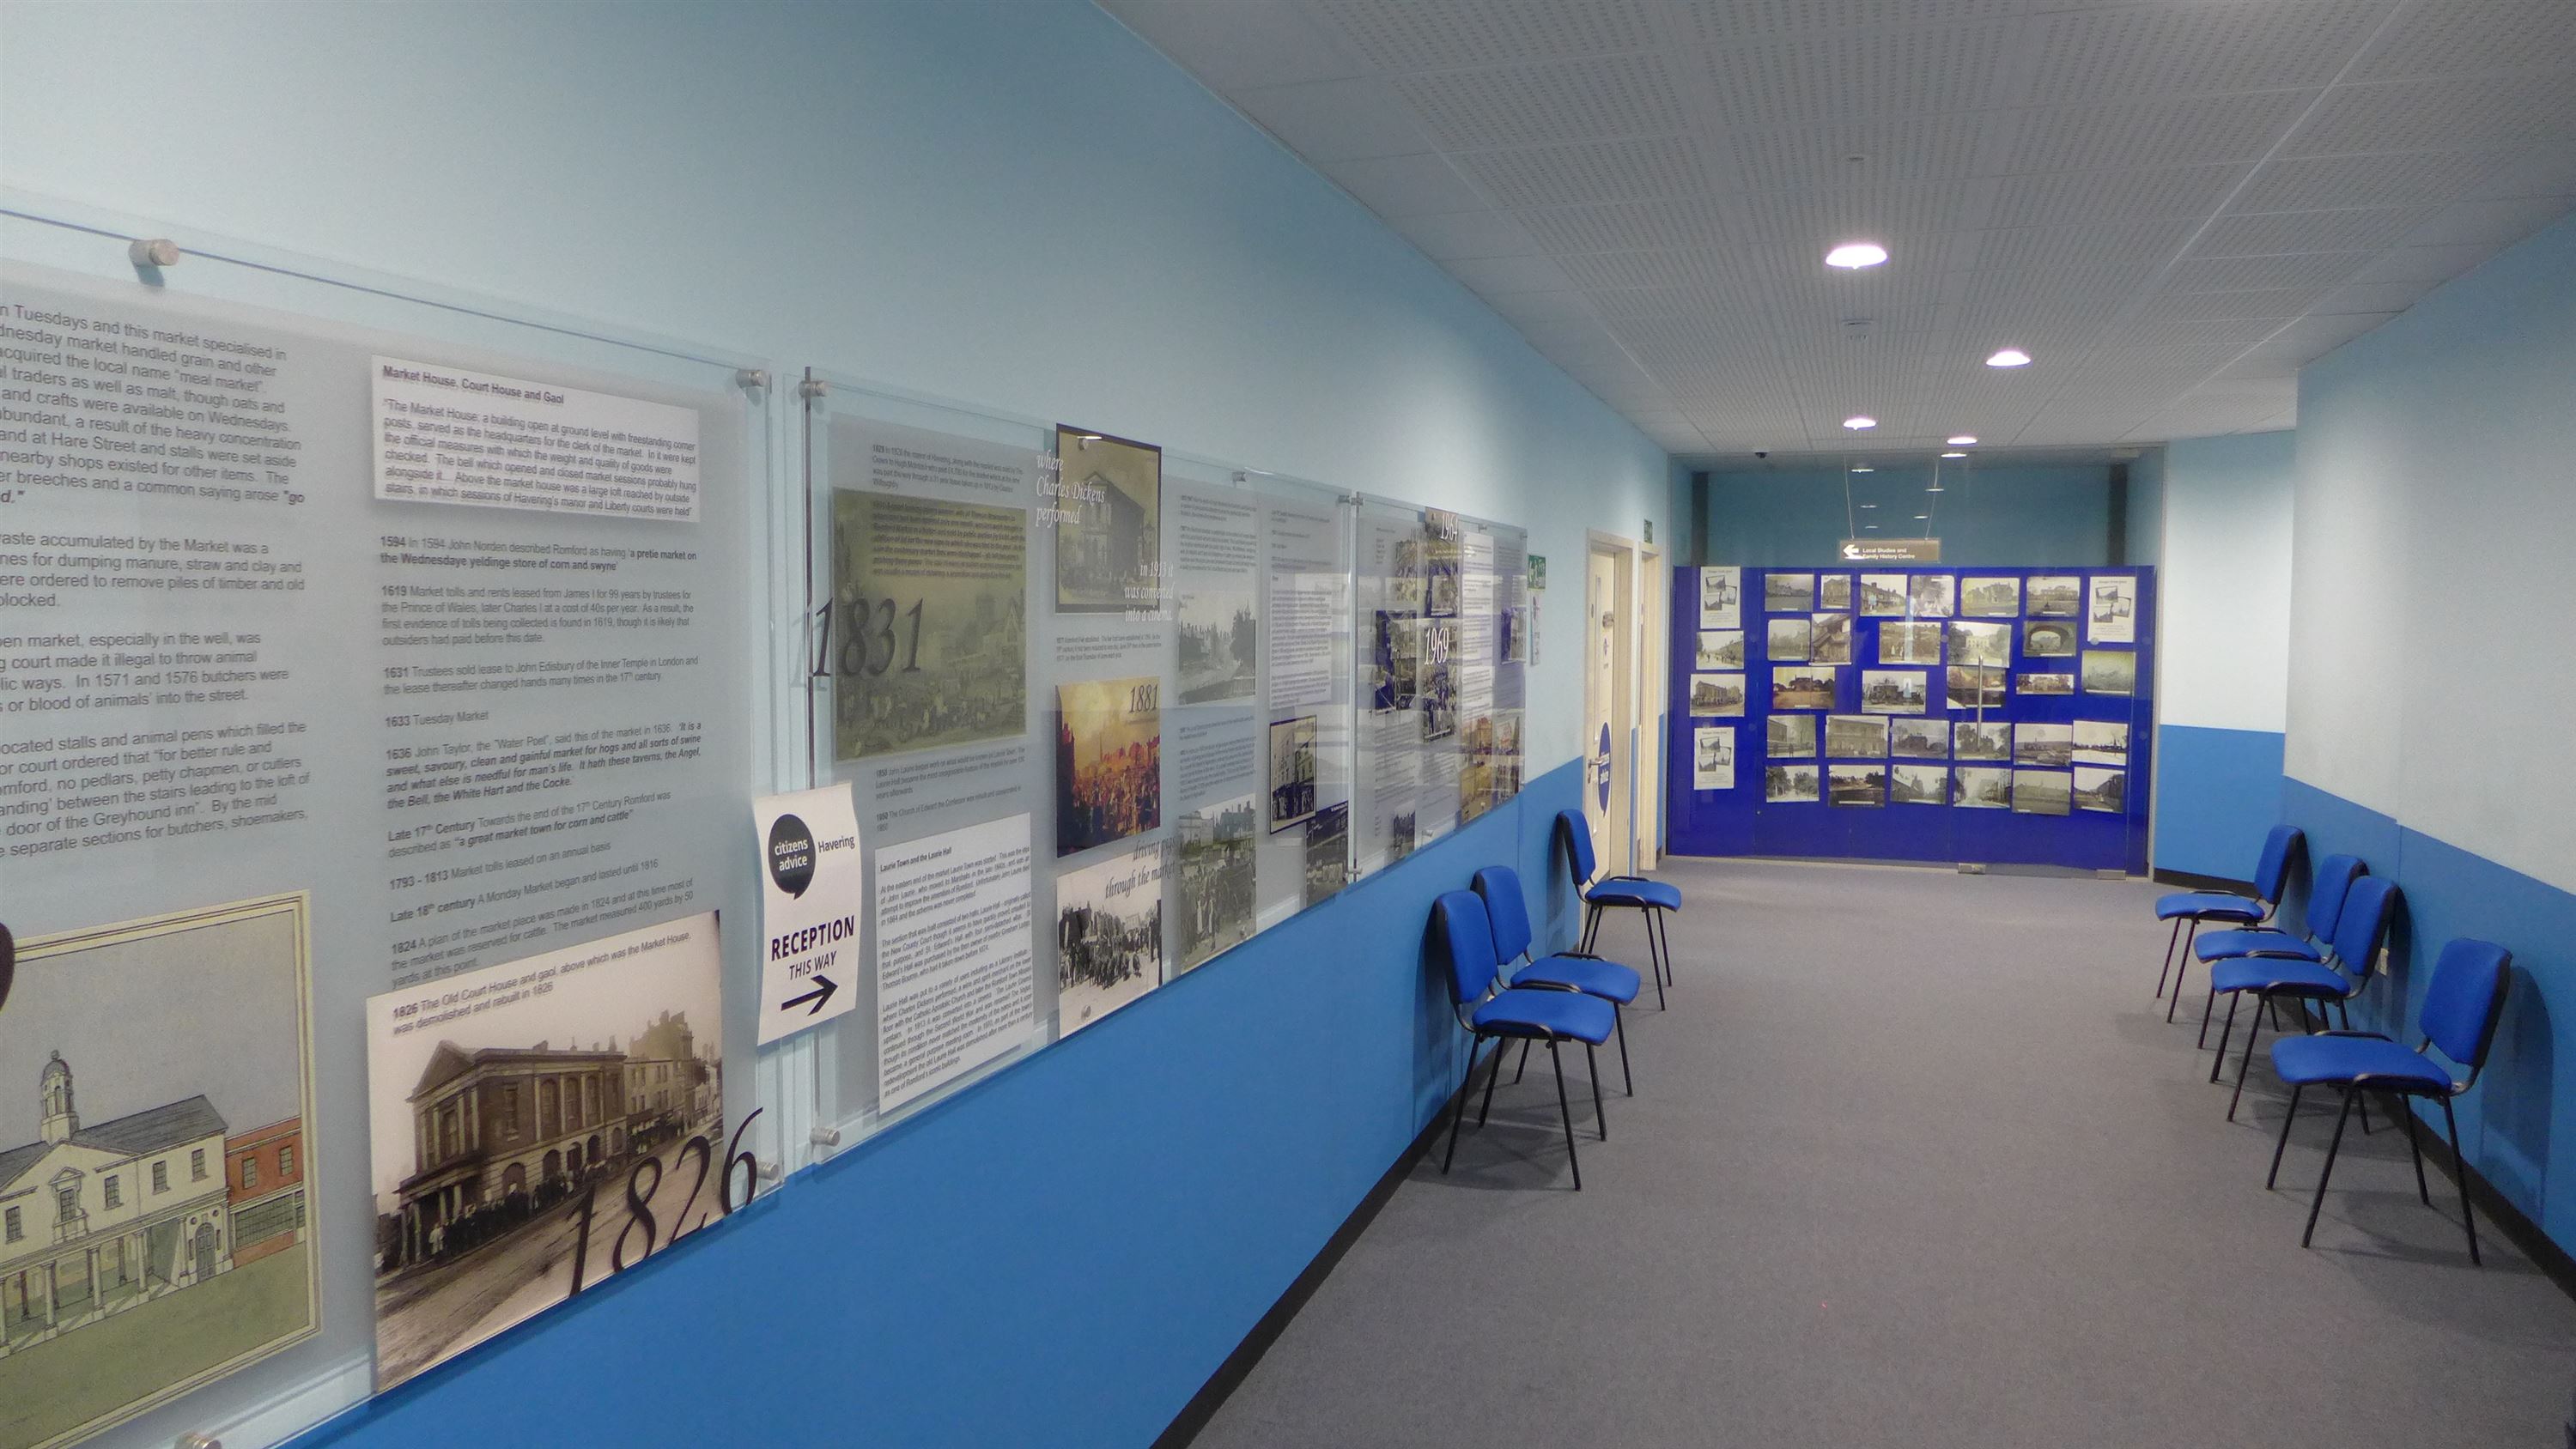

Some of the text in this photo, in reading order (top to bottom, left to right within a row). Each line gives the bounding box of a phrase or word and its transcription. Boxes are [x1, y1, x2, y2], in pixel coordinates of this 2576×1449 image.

[14, 304, 286, 361] Tuesdays and this market specialised in
[383, 363, 420, 381] Market
[461, 377, 488, 392] Court
[492, 381, 522, 397] House
[525, 389, 541, 400] and
[544, 391, 563, 403] Gaol
[3, 387, 31, 402] and
[36, 391, 78, 408] crafts
[84, 398, 118, 412] were
[123, 402, 184, 420] available
[188, 410, 204, 421] on
[2, 450, 52, 469] nearby
[58, 453, 103, 472] shops
[108, 458, 157, 474] existed
[162, 461, 179, 476] for
[184, 464, 217, 478] other
[265, 470, 289, 484] The
[1036, 450, 1063, 471] where
[17, 469, 88, 488] breeches
[93, 476, 118, 490] and
[124, 480, 132, 491] a
[137, 482, 195, 495] common
[199, 485, 240, 501] saying
[246, 489, 278, 501] arose
[1036, 472, 1105, 506] Charles Dickens
[1036, 501, 1082, 528] performed
[380, 535, 406, 547] 1594
[422, 537, 445, 549] 1594
[449, 538, 471, 549] John
[473, 539, 507, 551] Norden
[553, 543, 587, 555] Romford
[602, 546, 626, 559] having
[660, 550, 685, 560] market
[380, 552, 397, 563] the
[513, 557, 536, 567] store
[539, 558, 548, 568] of
[573, 560, 587, 569] and
[1126, 604, 1140, 622] into
[812, 597, 923, 677] 1831
[1424, 627, 1449, 665] 1969
[22, 677, 66, 692] ways.
[95, 672, 130, 687] 1571
[135, 671, 160, 685] and
[166, 670, 197, 683] 1576
[203, 669, 256, 682] butchers
[259, 670, 289, 680] were
[9, 700, 25, 712] or
[29, 695, 70, 710] blood
[76, 694, 89, 708] of
[156, 691, 180, 704] into
[185, 689, 205, 702] the
[1128, 683, 1158, 713] 1881
[386, 709, 489, 727] 1633 Tuesday Market
[6, 822, 41, 836] door
[46, 816, 61, 831] of
[65, 814, 88, 829] the
[93, 804, 171, 826] Greyhound
[212, 798, 228, 814] By
[233, 796, 252, 809] the
[256, 792, 276, 806] mid
[440, 840, 451, 850] as
[468, 831, 493, 847] great
[495, 825, 527, 840] market
[531, 823, 551, 834] town
[555, 820, 567, 830] for
[590, 813, 605, 825] and
[775, 838, 808, 856] citizens
[818, 835, 855, 852] Havering
[390, 875, 414, 889] 1793
[426, 869, 448, 883] 1813
[450, 863, 483, 879] Market
[485, 859, 503, 872] tolls
[506, 853, 534, 869] leased
[537, 853, 547, 863] on
[550, 852, 560, 861] an
[562, 844, 588, 858] annual
[591, 840, 611, 853] basis
[779, 854, 807, 871] advice
[880, 861, 896, 872] Laurie
[897, 858, 909, 868] Town
[911, 854, 920, 864] and
[928, 849, 942, 859] Laurie
[943, 846, 951, 856] Hall
[1133, 840, 1160, 862] driving
[1105, 860, 1176, 899] through the market
[771, 915, 855, 961] RECEPTION
[393, 1002, 417, 1019] 1826
[422, 997, 439, 1011] The
[442, 991, 459, 1005] Old
[462, 983, 487, 1000] Court
[489, 978, 518, 992] House
[520, 970, 536, 985] and
[560, 960, 585, 973] above
[587, 951, 609, 967] which
[611, 949, 626, 960] was
[628, 944, 639, 955] the
[641, 937, 665, 952] Market
[789, 951, 836, 980] THIS WAY
[564, 1107, 763, 1297] 1826
